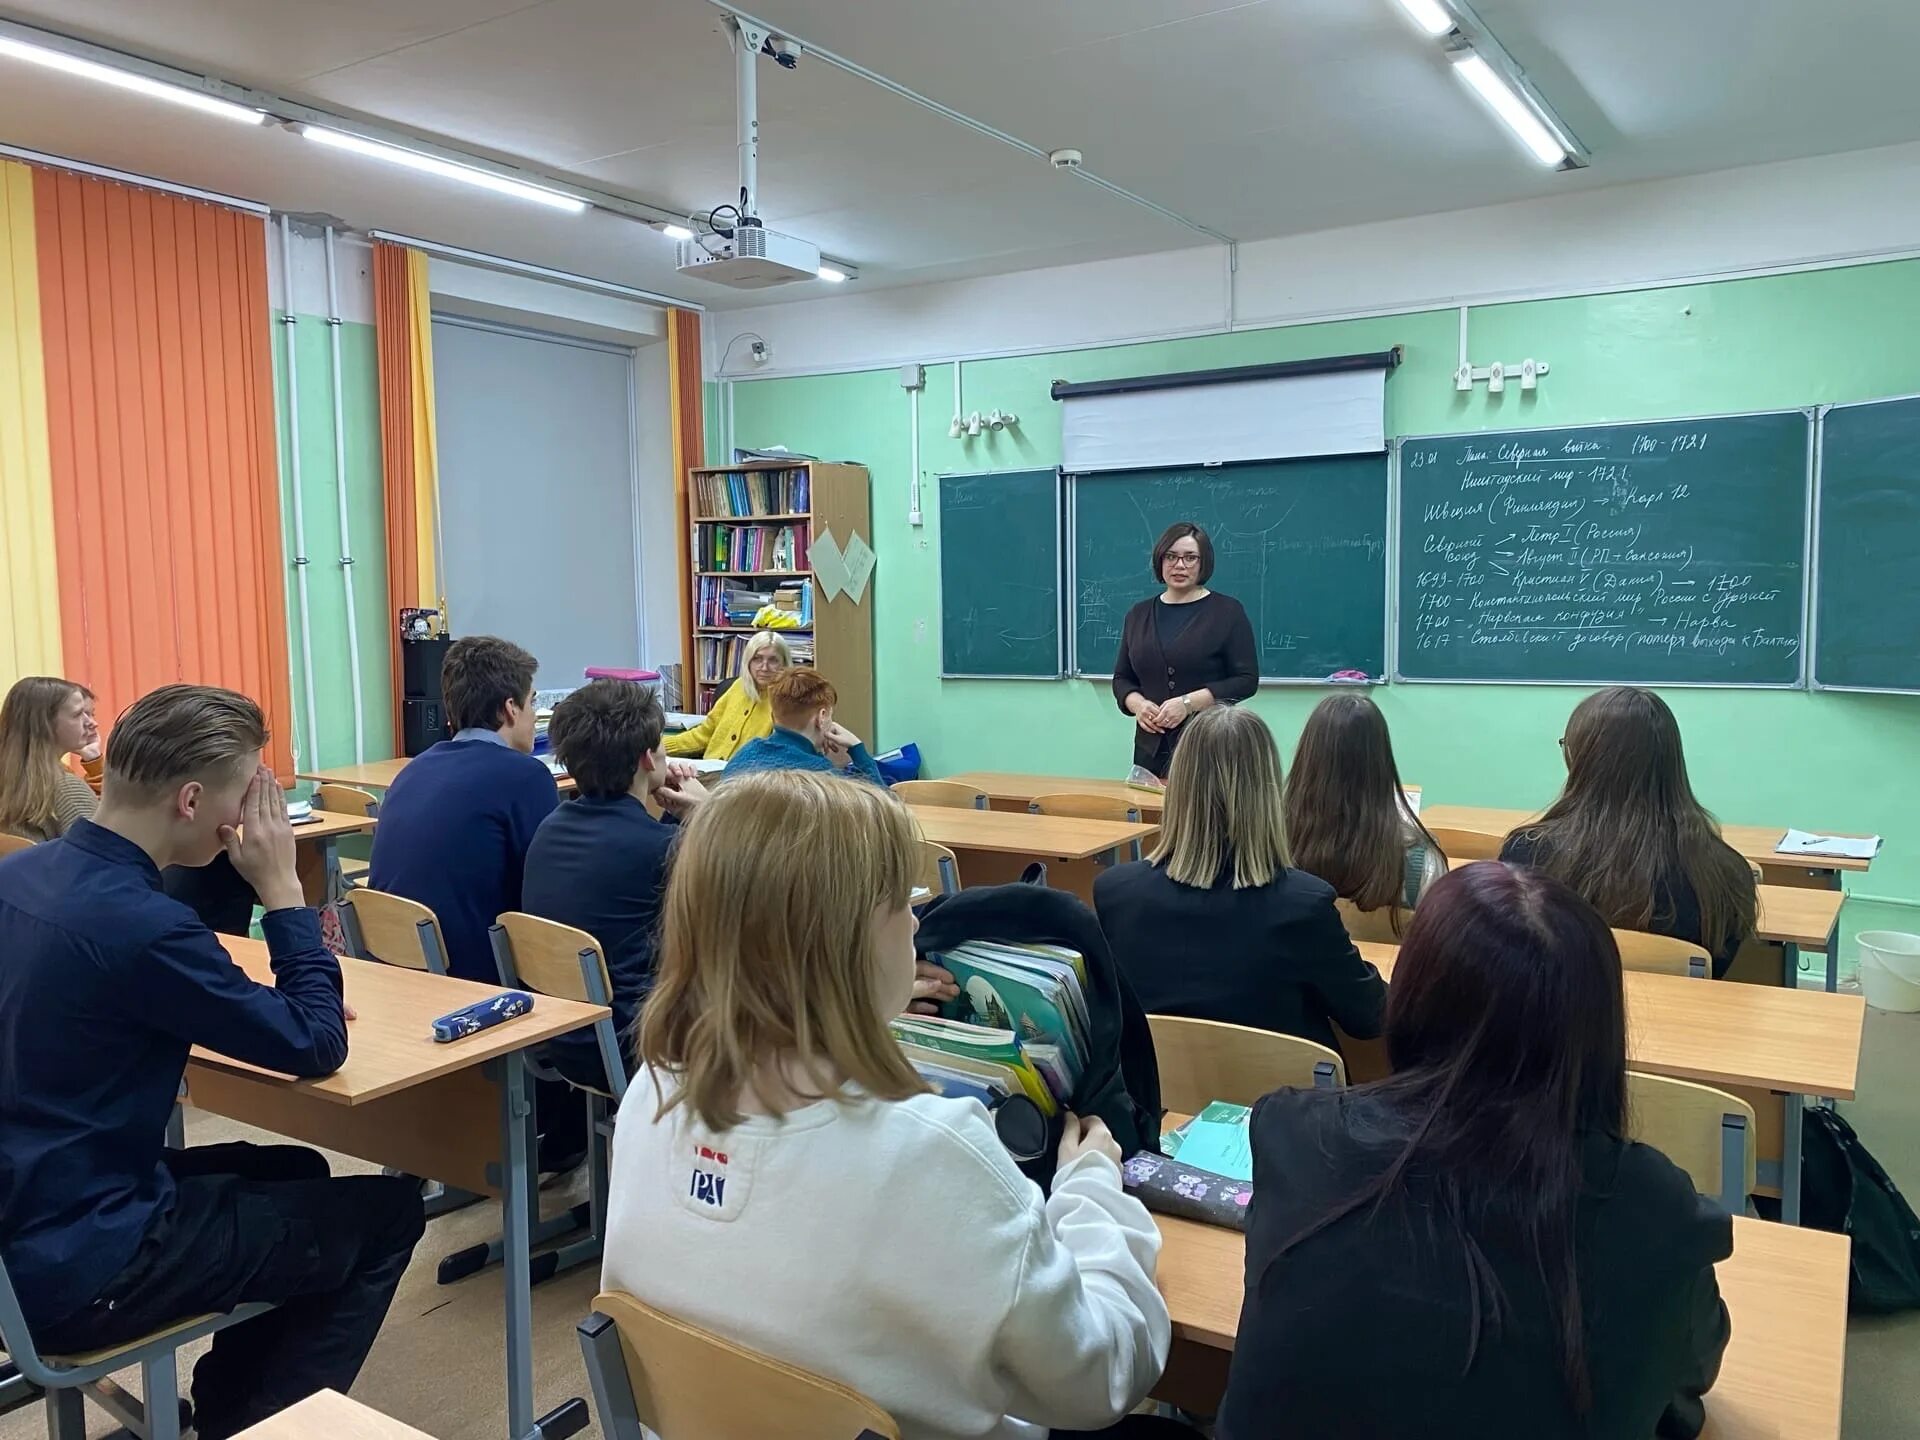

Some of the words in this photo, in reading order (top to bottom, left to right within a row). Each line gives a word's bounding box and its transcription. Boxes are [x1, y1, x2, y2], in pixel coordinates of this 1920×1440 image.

[1498, 442, 1549, 469] Северная
[1548, 467, 1575, 488] мир
[1424, 502, 1485, 523] Швеция
[1488, 492, 1586, 525] (Финляндия)
[1625, 486, 1664, 509] Карл
[1671, 484, 1691, 500] 12
[1424, 533, 1485, 560] Северный
[1521, 525, 1559, 545] Петр
[1573, 520, 1642, 548] (Россия)
[1516, 546, 1563, 570] Август
[1625, 546, 1694, 572] Саксония)
[1512, 573, 1576, 594] Кристиан
[1593, 568, 1664, 597] (Дания)
[1419, 593, 1452, 611] 1700
[1614, 593, 1641, 615] мир
[1654, 589, 1697, 607] России
[1702, 594, 1711, 603] с
[1416, 613, 1450, 631] 1700
[1674, 611, 1737, 637] Нарва
[1416, 632, 1452, 650] 1617
[1568, 631, 1625, 652] договор
[1625, 631, 1685, 657] (потеря
[1741, 634, 1750, 646] к
